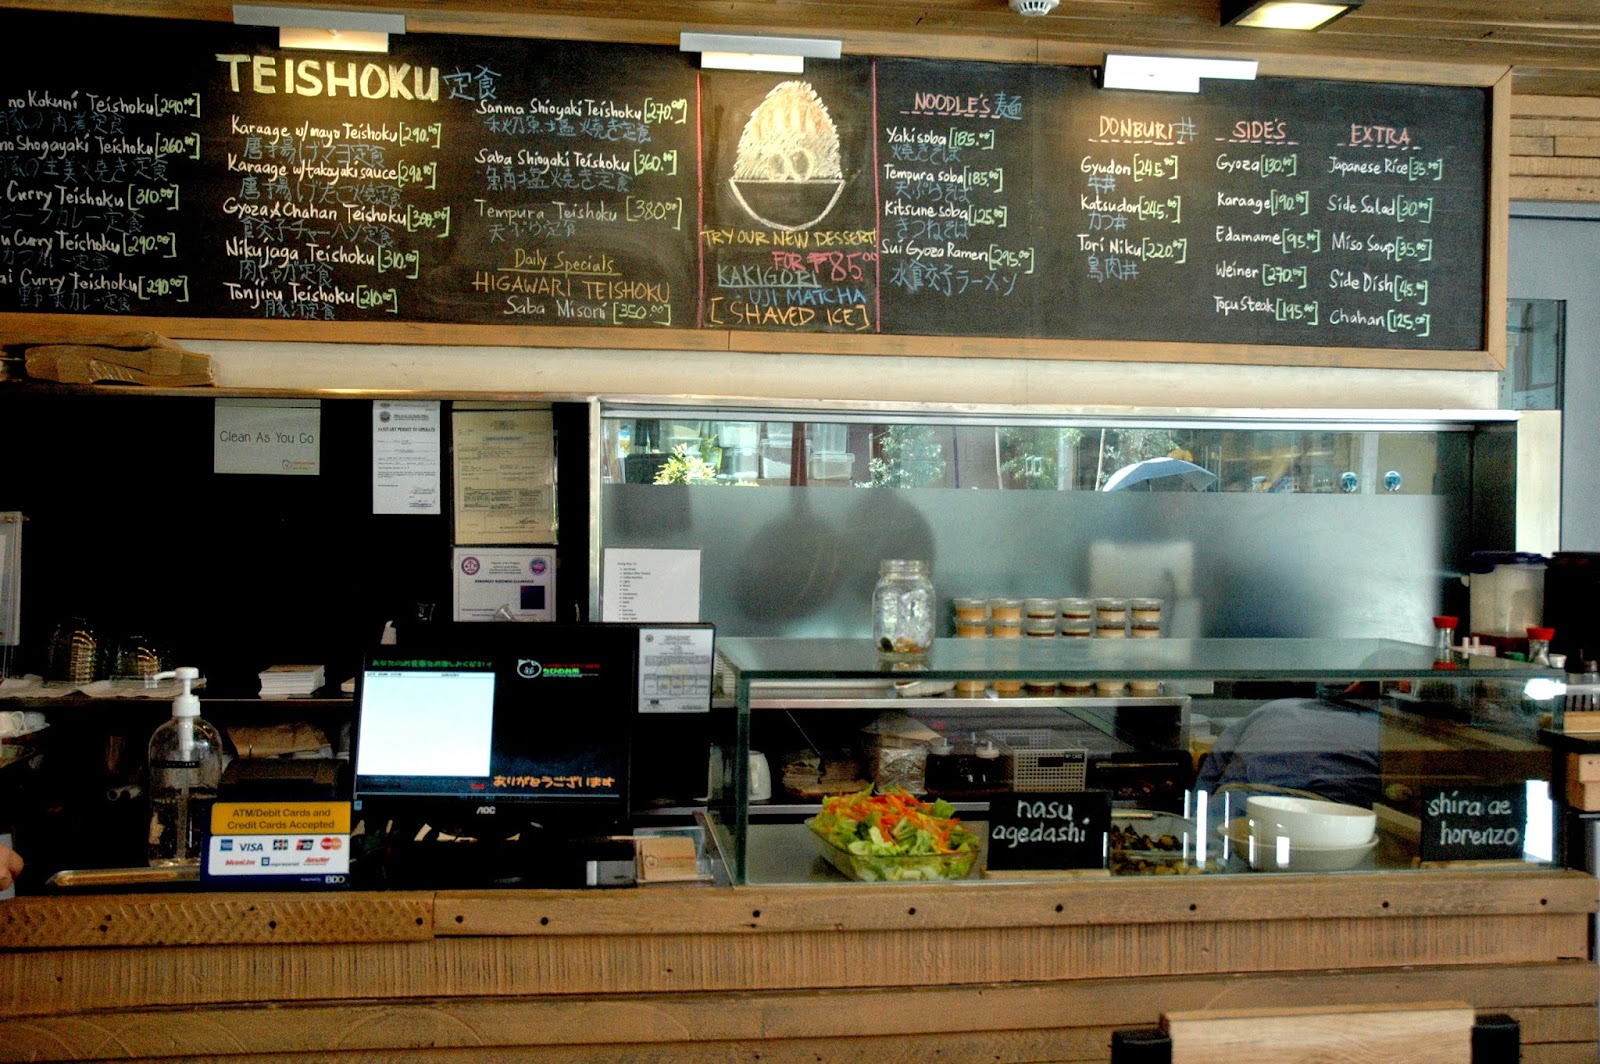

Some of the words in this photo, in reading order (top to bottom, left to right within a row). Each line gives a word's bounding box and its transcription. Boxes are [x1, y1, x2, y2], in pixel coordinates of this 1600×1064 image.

[216, 53, 440, 102] TEISHOKU
[442, 64, 501, 101] 定食
[86, 92, 154, 114] Teishoku
[475, 98, 525, 115] Sanma
[530, 97, 582, 121] Shioyaki
[584, 98, 642, 120] Teishoku
[914, 92, 991, 114] NOODLE'S
[231, 114, 290, 145] Karaage
[342, 123, 398, 143] Teishoku
[1099, 115, 1173, 140] DONBURI
[1232, 118, 1287, 139] SIDE'S
[1350, 123, 1411, 145] EXTRA
[16, 134, 90, 160] Shogayaki
[95, 136, 153, 155] Teishoku
[227, 153, 288, 182] Karaage
[360, 166, 398, 180] sauce
[474, 148, 512, 165] Saba
[517, 148, 570, 175] Shioyaki
[573, 151, 631, 172] Teishoku
[1080, 155, 1132, 175] Gyudon
[1216, 154, 1260, 173] Gyoza
[1327, 156, 1382, 178] Japanese
[1384, 157, 1408, 174] Rice
[884, 163, 935, 185] Tempura
[938, 167, 963, 184] soba
[7, 180, 52, 210] Curry
[54, 185, 124, 207] Teishoku
[1080, 193, 1140, 214] Katsudon
[1217, 191, 1271, 215] Karaage
[1327, 194, 1357, 213] Side
[1361, 195, 1396, 216] Salad
[222, 197, 268, 219] Gyoza
[283, 202, 337, 221] Chahan
[343, 202, 407, 226] Teishoku
[474, 198, 545, 226] Tempura
[552, 200, 618, 222] Teishoku
[885, 199, 937, 216] Kitsune
[938, 202, 968, 220] soba
[14, 229, 53, 258] Curry
[700, 228, 734, 249] TRY
[737, 230, 770, 245] OUR
[773, 230, 809, 249] NEW
[1077, 233, 1105, 252] Tori
[1109, 238, 1142, 257] Niku
[1215, 225, 1283, 246] Edamame
[1331, 231, 1363, 251] Miso
[1367, 234, 1396, 260] Soup
[225, 236, 299, 268] Nikujaga
[306, 242, 375, 266] Teishoku
[772, 251, 807, 272] FOR
[882, 239, 902, 254] Sui
[906, 240, 945, 260] Gyoza
[947, 242, 989, 262] Ramen
[515, 248, 548, 272] Daily
[555, 250, 614, 278] Specials
[1215, 260, 1260, 278] Weiner
[20, 268, 65, 294] Curry
[69, 272, 137, 293] Teishoku
[717, 264, 820, 287] KAKIGORI
[1329, 269, 1360, 289] Side
[1363, 271, 1394, 294] Dish
[222, 278, 283, 309] Tonjiru
[288, 281, 355, 304] Teishoku
[472, 271, 572, 298] HIGAWARI
[581, 280, 671, 304] TEISHOKU
[749, 289, 778, 307] UJI
[786, 287, 867, 306] MATCHA
[503, 295, 546, 315] Saba
[1240, 295, 1276, 313] Steak
[1329, 309, 1385, 327] Chahan
[220, 430, 251, 442] Clean
[256, 431, 271, 443] As
[275, 432, 295, 444] You
[299, 432, 315, 444] Go
[233, 808, 281, 818] ATM/Debit
[283, 808, 311, 818] Cards
[313, 808, 331, 817] and
[476, 806, 496, 815] AOC
[1017, 799, 1074, 821] nasu
[1427, 790, 1481, 817] shira
[1487, 800, 1512, 815] ae
[227, 821, 257, 830] Credit
[259, 820, 287, 830] Cards
[289, 819, 335, 831] Accepted
[992, 817, 1091, 849] agedashi
[1440, 820, 1520, 846] horenzo
[239, 842, 264, 852] VISA
[325, 875, 346, 885] BDO
